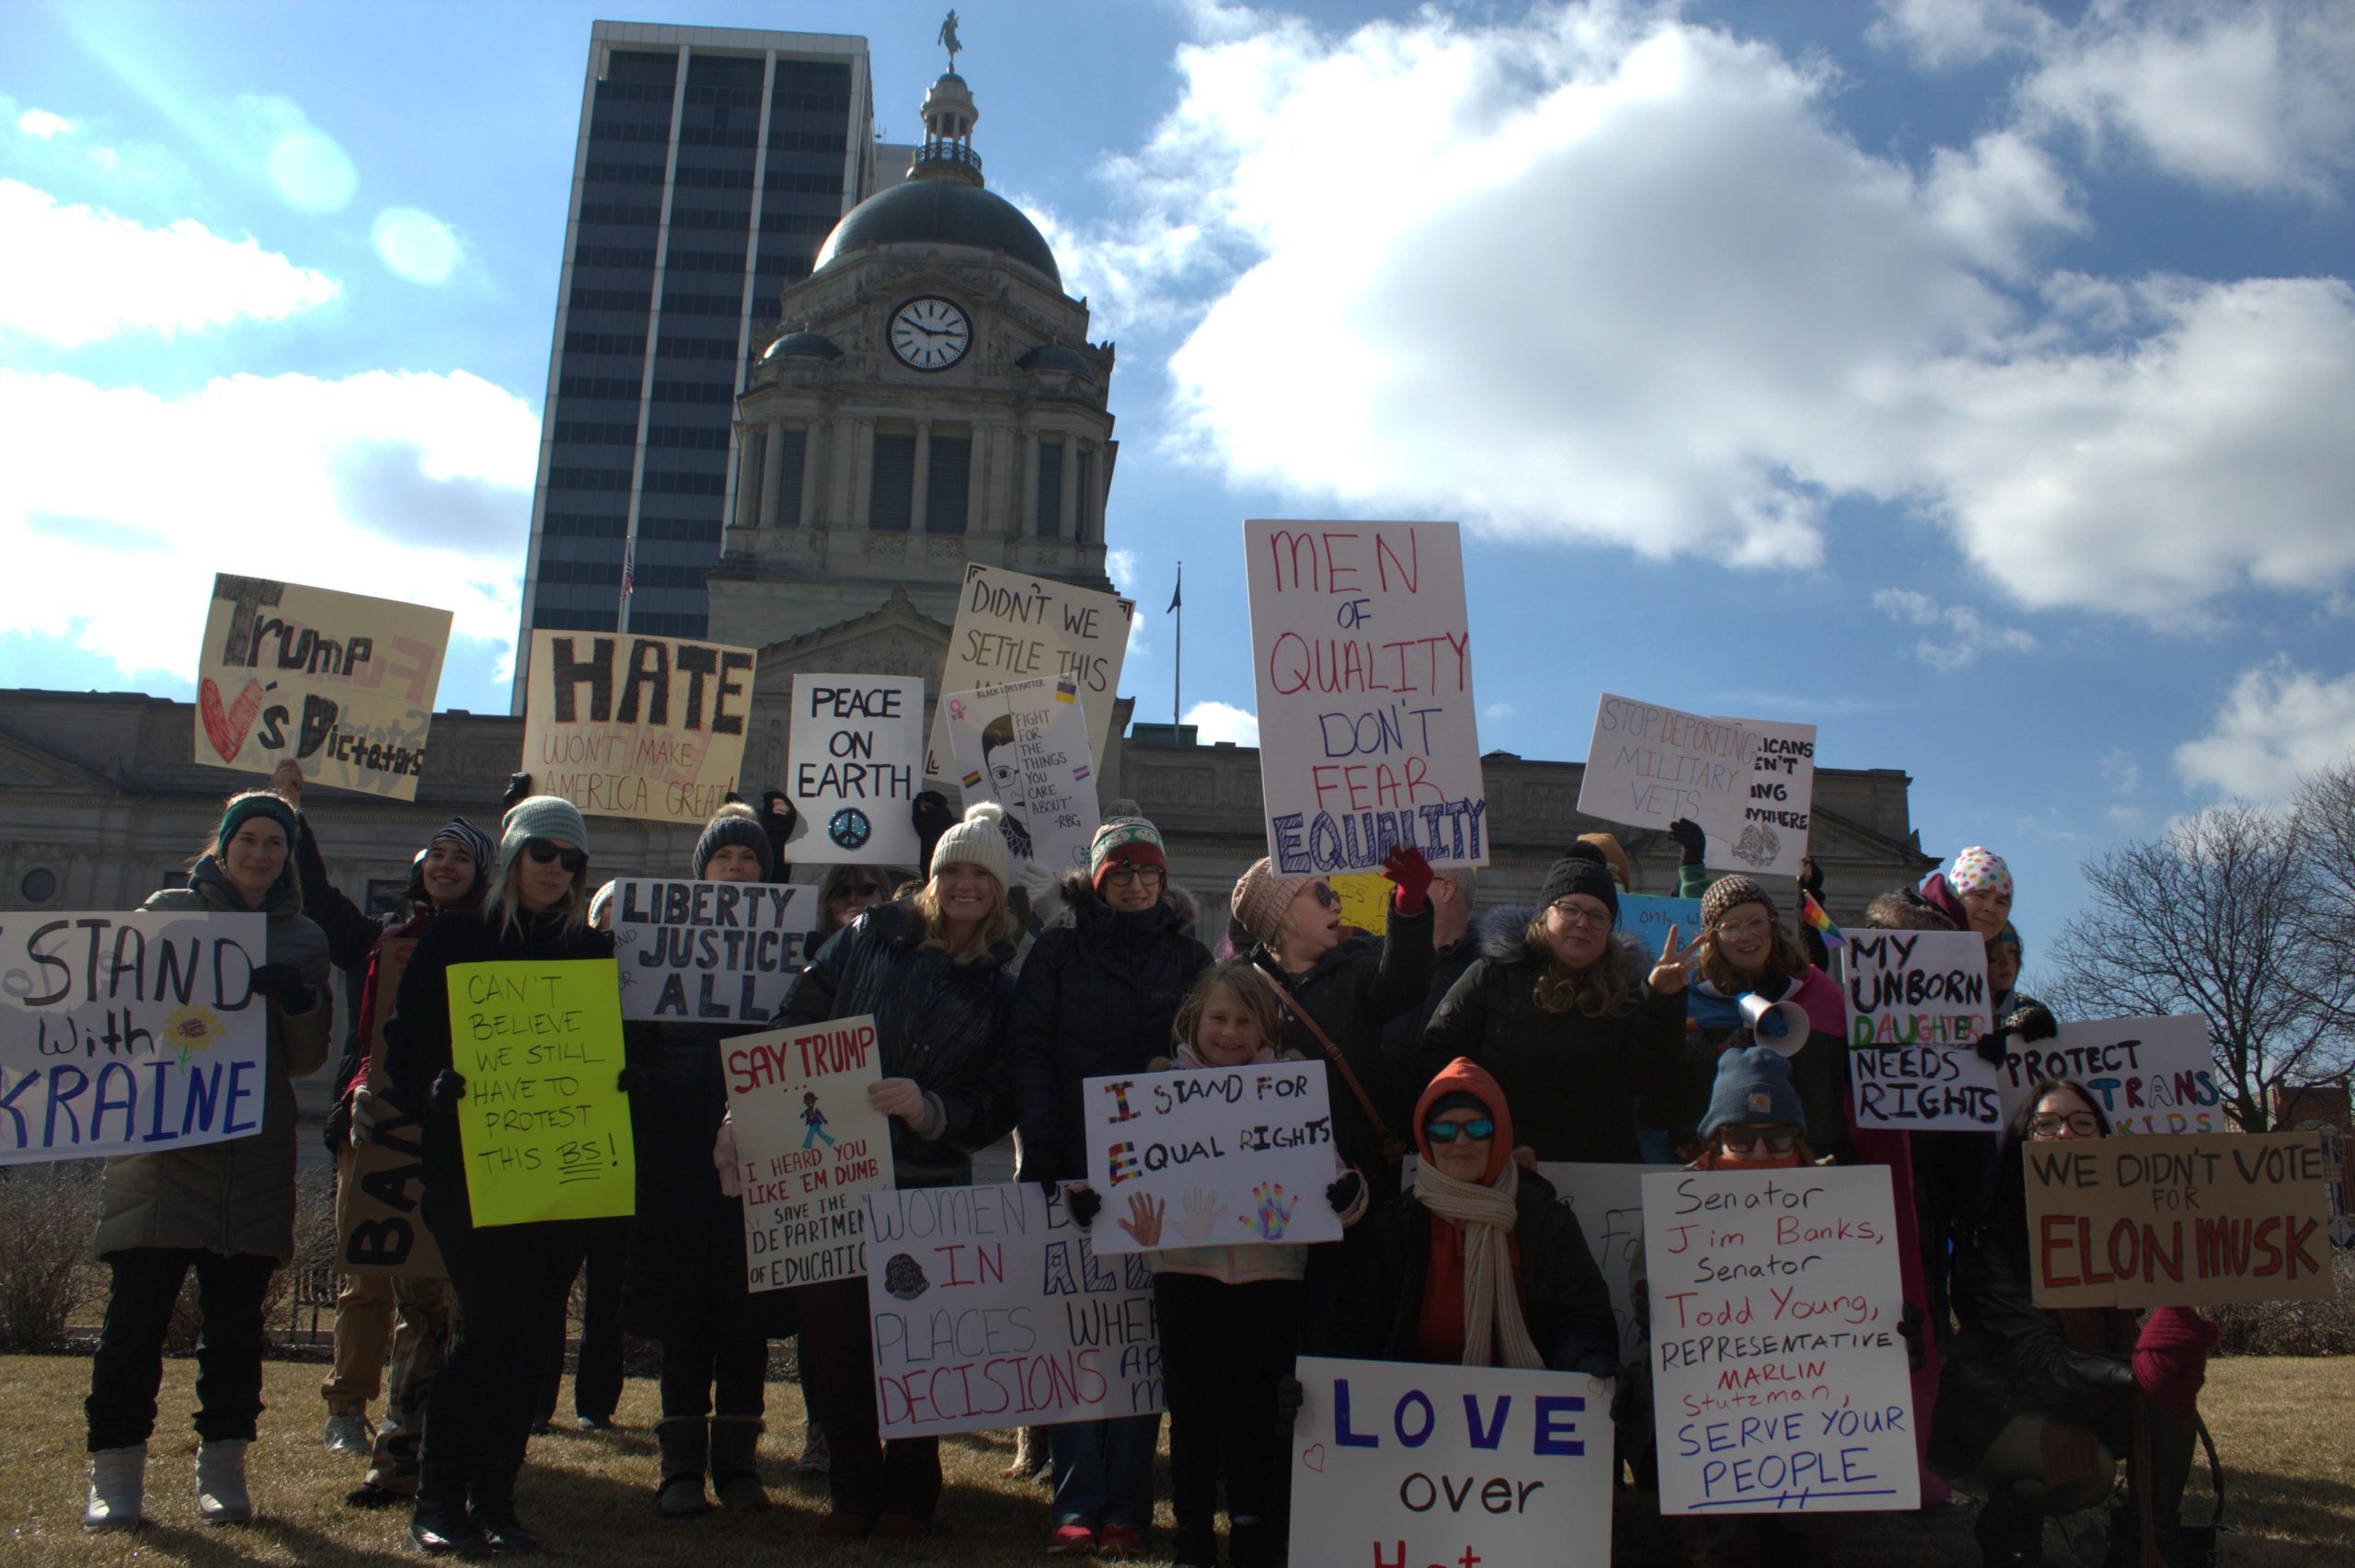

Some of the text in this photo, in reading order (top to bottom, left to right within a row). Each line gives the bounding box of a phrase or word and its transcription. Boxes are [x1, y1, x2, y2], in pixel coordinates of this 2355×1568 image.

[1270, 528, 1418, 594] MEN
[213, 572, 373, 676] Trump
[971, 579, 1099, 639] DIDN'T WE
[1338, 599, 1372, 629] OF
[961, 629, 1108, 692] SETTLE THIS
[1269, 632, 1469, 695] QUALITY
[553, 636, 754, 735] HATE
[811, 688, 902, 718] PEACE
[829, 730, 873, 759] ON
[1018, 727, 1042, 742] FOR
[1019, 742, 1045, 756] THE
[1319, 699, 1442, 757] DON'T
[1602, 699, 1758, 765] STOP DEPORTING
[1758, 738, 1813, 758] ICANS
[544, 735, 622, 764] WON'T
[637, 739, 692, 767] MAKE
[1021, 752, 1067, 770] THINGS
[1614, 746, 1740, 793] MILITARY
[545, 771, 648, 813] AMERICA
[798, 763, 911, 800] EARTH
[1026, 773, 1048, 784] YOU
[1028, 784, 1057, 799] CARE
[1312, 757, 1445, 810] FEAR
[1631, 780, 1701, 820] VETS
[1272, 797, 1485, 874] EQUALITY
[622, 882, 797, 928] LIBERTY
[24, 920, 254, 1011] STAND
[615, 926, 805, 974] ND JUSTICE
[1850, 934, 1919, 969] MY
[468, 975, 562, 1008] CAN'T
[653, 973, 769, 1021] ALL
[1851, 968, 1983, 1013] UNBORN
[468, 1011, 583, 1040] BELIEVE
[1854, 1013, 1987, 1046] DAUGHTER
[476, 1043, 605, 1072] WE STILL
[728, 1026, 875, 1093] SAY TRUMP
[1856, 1047, 1959, 1082] NEEDS
[2005, 1039, 2142, 1088] PROTECT
[474, 1076, 579, 1105] HAVE TO
[1105, 1074, 1307, 1124] I STAND FOR
[1860, 1082, 1998, 1124] RIGHTS
[2087, 1070, 2219, 1111] TRANS
[487, 1104, 592, 1139] PROTEST
[2116, 1113, 2212, 1134] KIDS
[478, 1147, 542, 1175] THIS
[745, 1139, 867, 1183] I HEARD YOU
[1109, 1116, 1330, 1187] EQUAL RIGHTS
[2030, 1145, 2324, 1188] WE DIDN'T VOTE
[748, 1181, 789, 1206] LIKE
[835, 1158, 879, 1185] DUMB
[1675, 1179, 1824, 1214] Senator
[2152, 1185, 2200, 1213] FOR
[775, 1194, 847, 1224] SAVE THE
[1666, 1224, 1745, 1253] Jim
[1776, 1215, 1884, 1245] Banks,
[2040, 1214, 2321, 1288] ELON MUSK
[751, 1266, 766, 1284] OF
[934, 1243, 1004, 1288] IN
[1694, 1254, 1822, 1283] Senator
[1665, 1292, 1754, 1329] Todd
[1770, 1286, 1878, 1325] Young,
[875, 1306, 1037, 1367] PLACES
[1660, 1332, 1894, 1371] REPRESENTATIVE
[879, 1349, 1107, 1425] DECISIONS
[1717, 1361, 1826, 1390] MARLIN
[1334, 1379, 1585, 1456] LOVE
[1678, 1406, 1906, 1457] SERVE YOUR
[1703, 1448, 1878, 1498] PEOPLE
